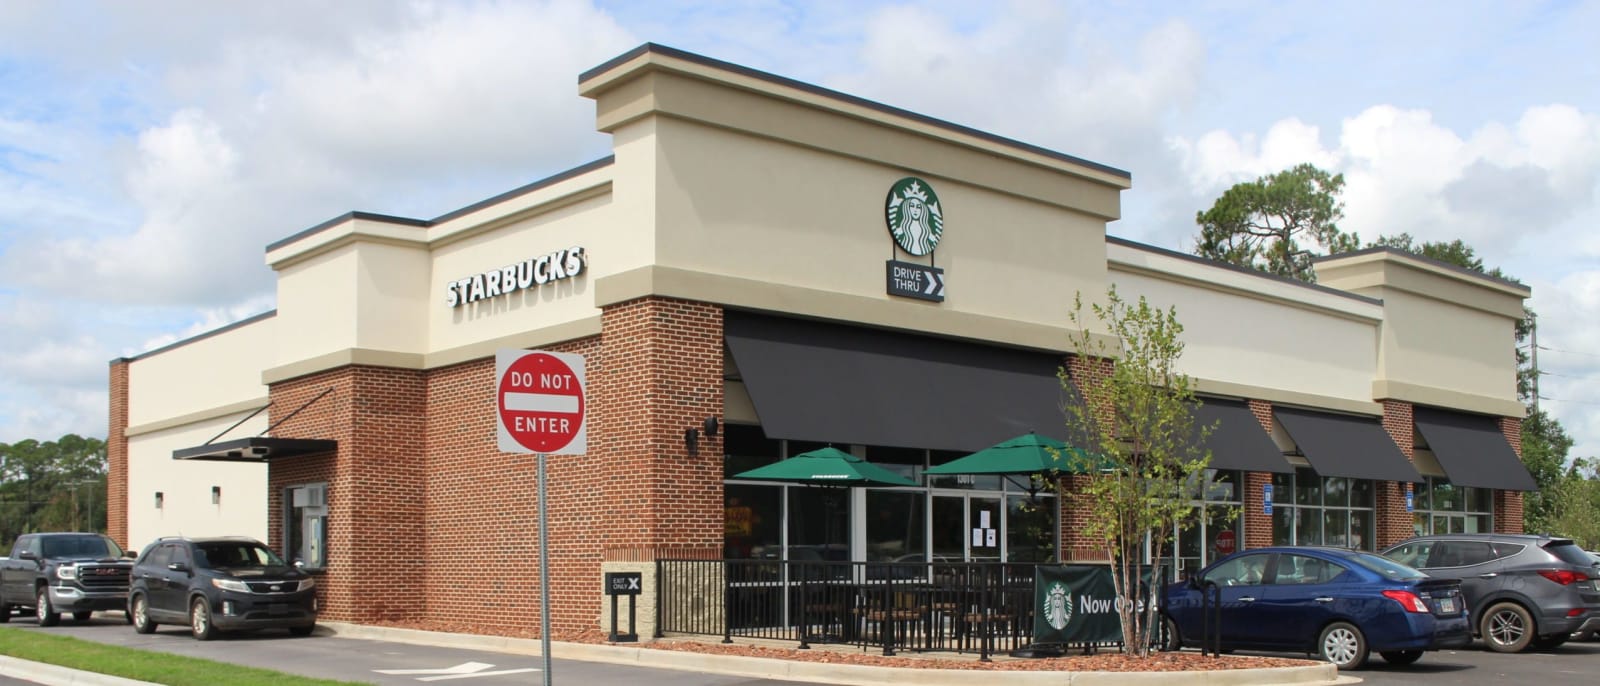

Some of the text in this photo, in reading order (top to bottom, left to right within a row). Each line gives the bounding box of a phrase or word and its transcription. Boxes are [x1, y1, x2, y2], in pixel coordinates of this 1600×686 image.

[447, 246, 584, 308] STARBUCKS
[893, 266, 922, 281] DRIVE
[894, 278, 920, 292] THRU
[511, 371, 571, 390] DO NOT
[515, 416, 570, 434] ENTER
[1080, 595, 1111, 614] Now
